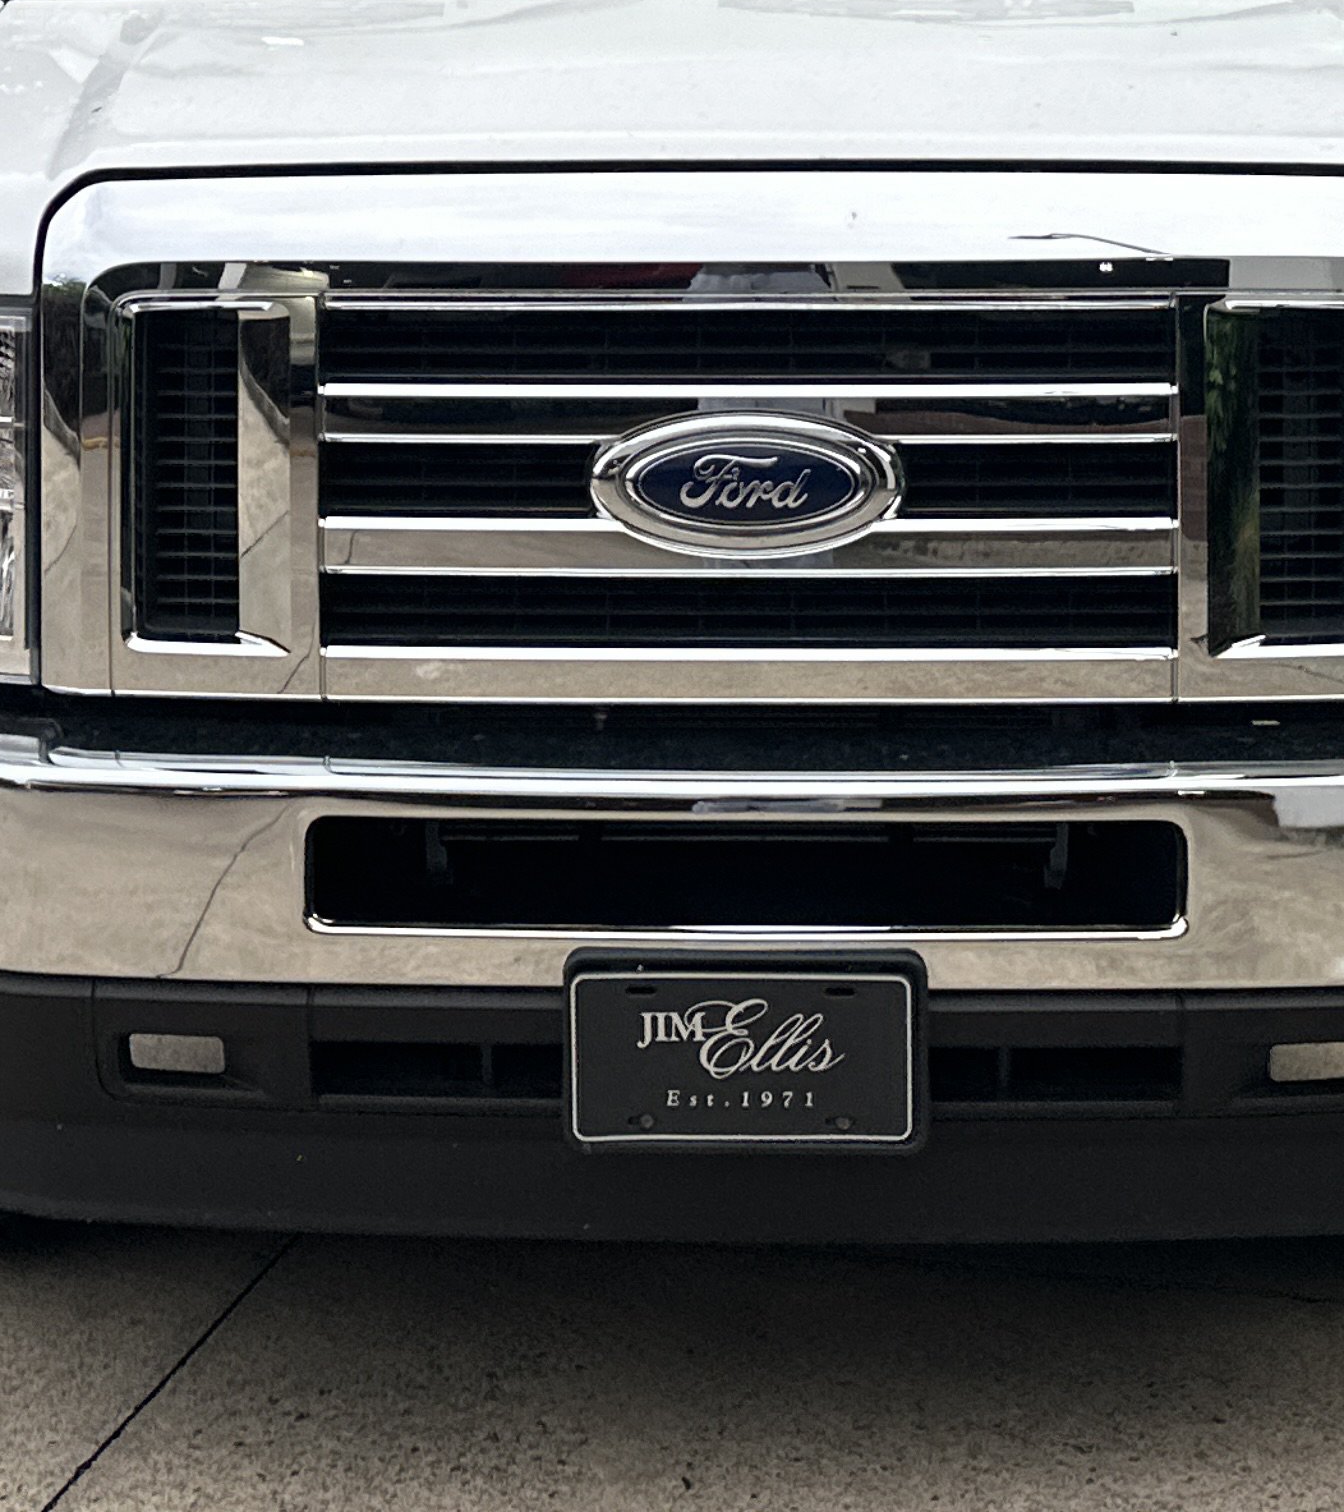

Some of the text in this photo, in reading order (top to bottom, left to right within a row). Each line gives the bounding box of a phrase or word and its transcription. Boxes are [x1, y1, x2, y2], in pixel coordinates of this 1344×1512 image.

[680, 454, 812, 509] Ford
[636, 998, 846, 1080] JIM Ellis
